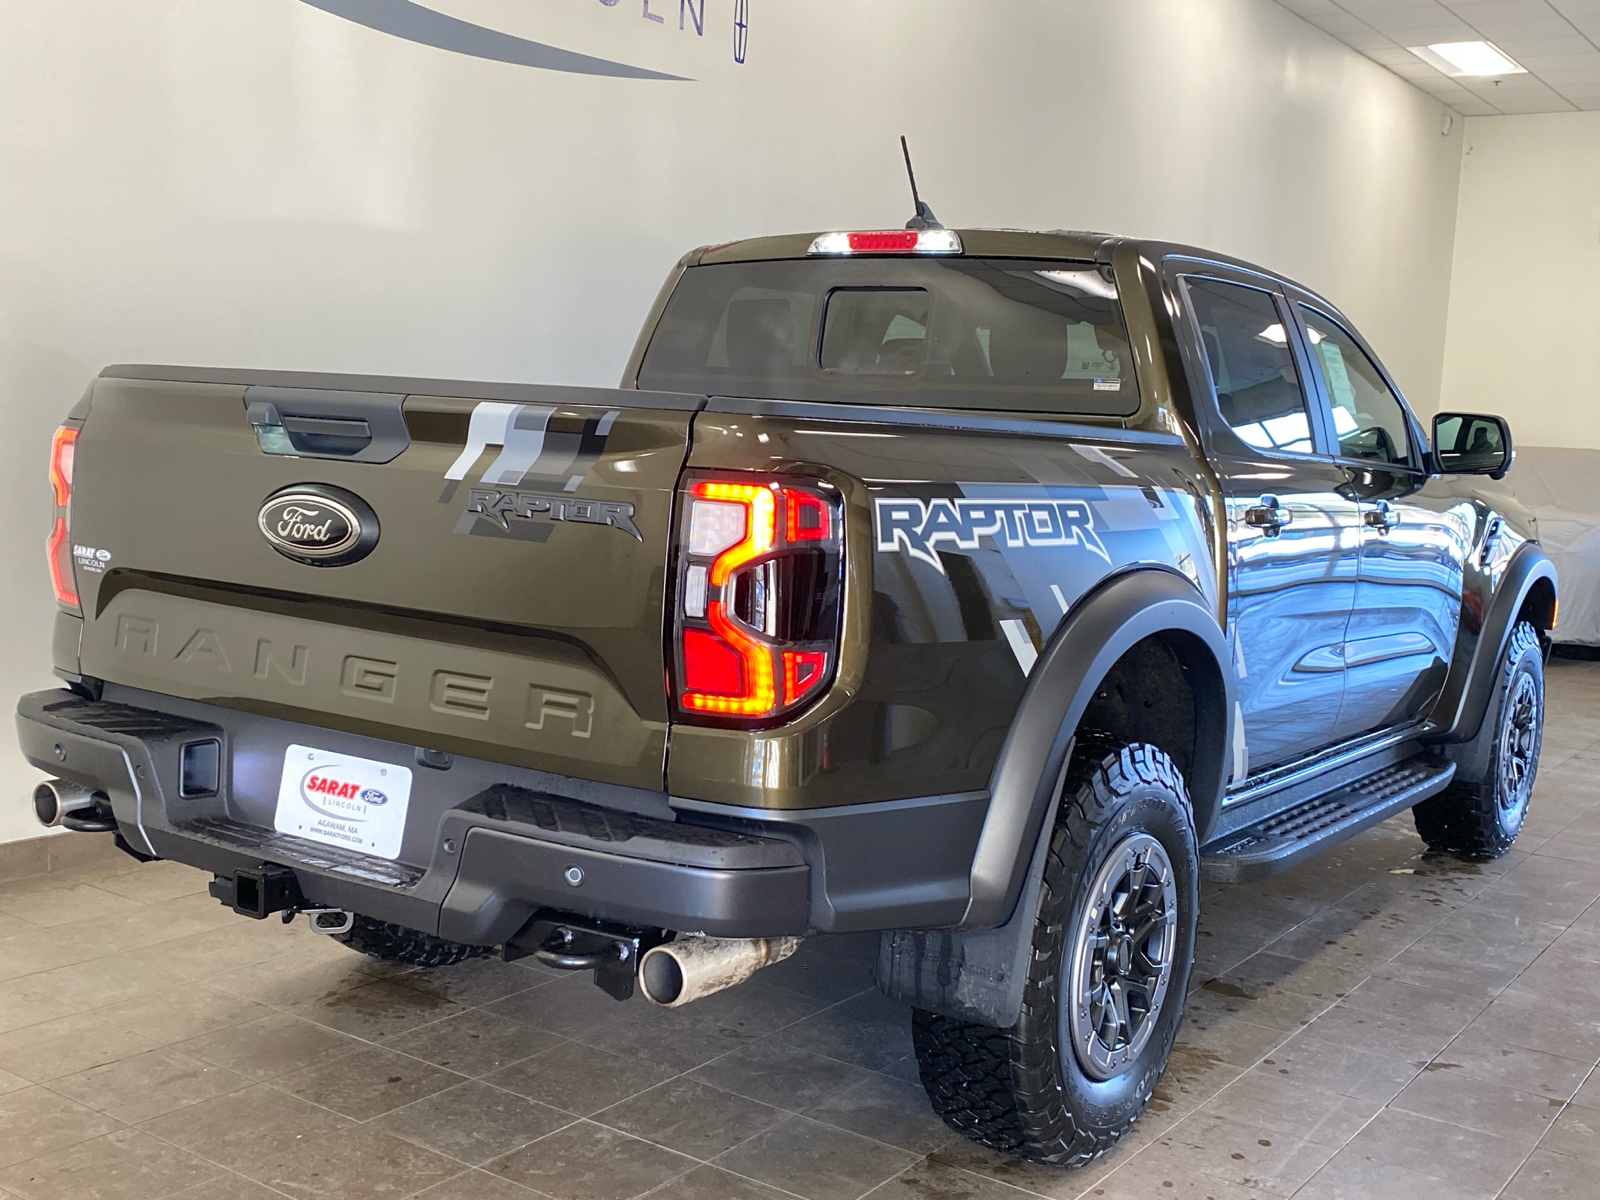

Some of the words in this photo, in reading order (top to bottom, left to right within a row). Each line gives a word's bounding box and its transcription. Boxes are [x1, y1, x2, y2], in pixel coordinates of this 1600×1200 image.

[277, 505, 331, 543] Ford
[467, 487, 644, 543] RAPTOR
[874, 497, 1113, 576] RAPTOR
[73, 544, 96, 559] SARAT
[78, 557, 105, 568] LINCOLN
[115, 613, 595, 738] RANGER
[306, 775, 361, 800] SARAT
[365, 790, 384, 804] Ford
[328, 799, 361, 812] LINCOLN
[310, 826, 363, 844] WWW.SARATFORD.COM
[317, 819, 347, 833] AGAWAM,
[348, 826, 358, 834] MA
